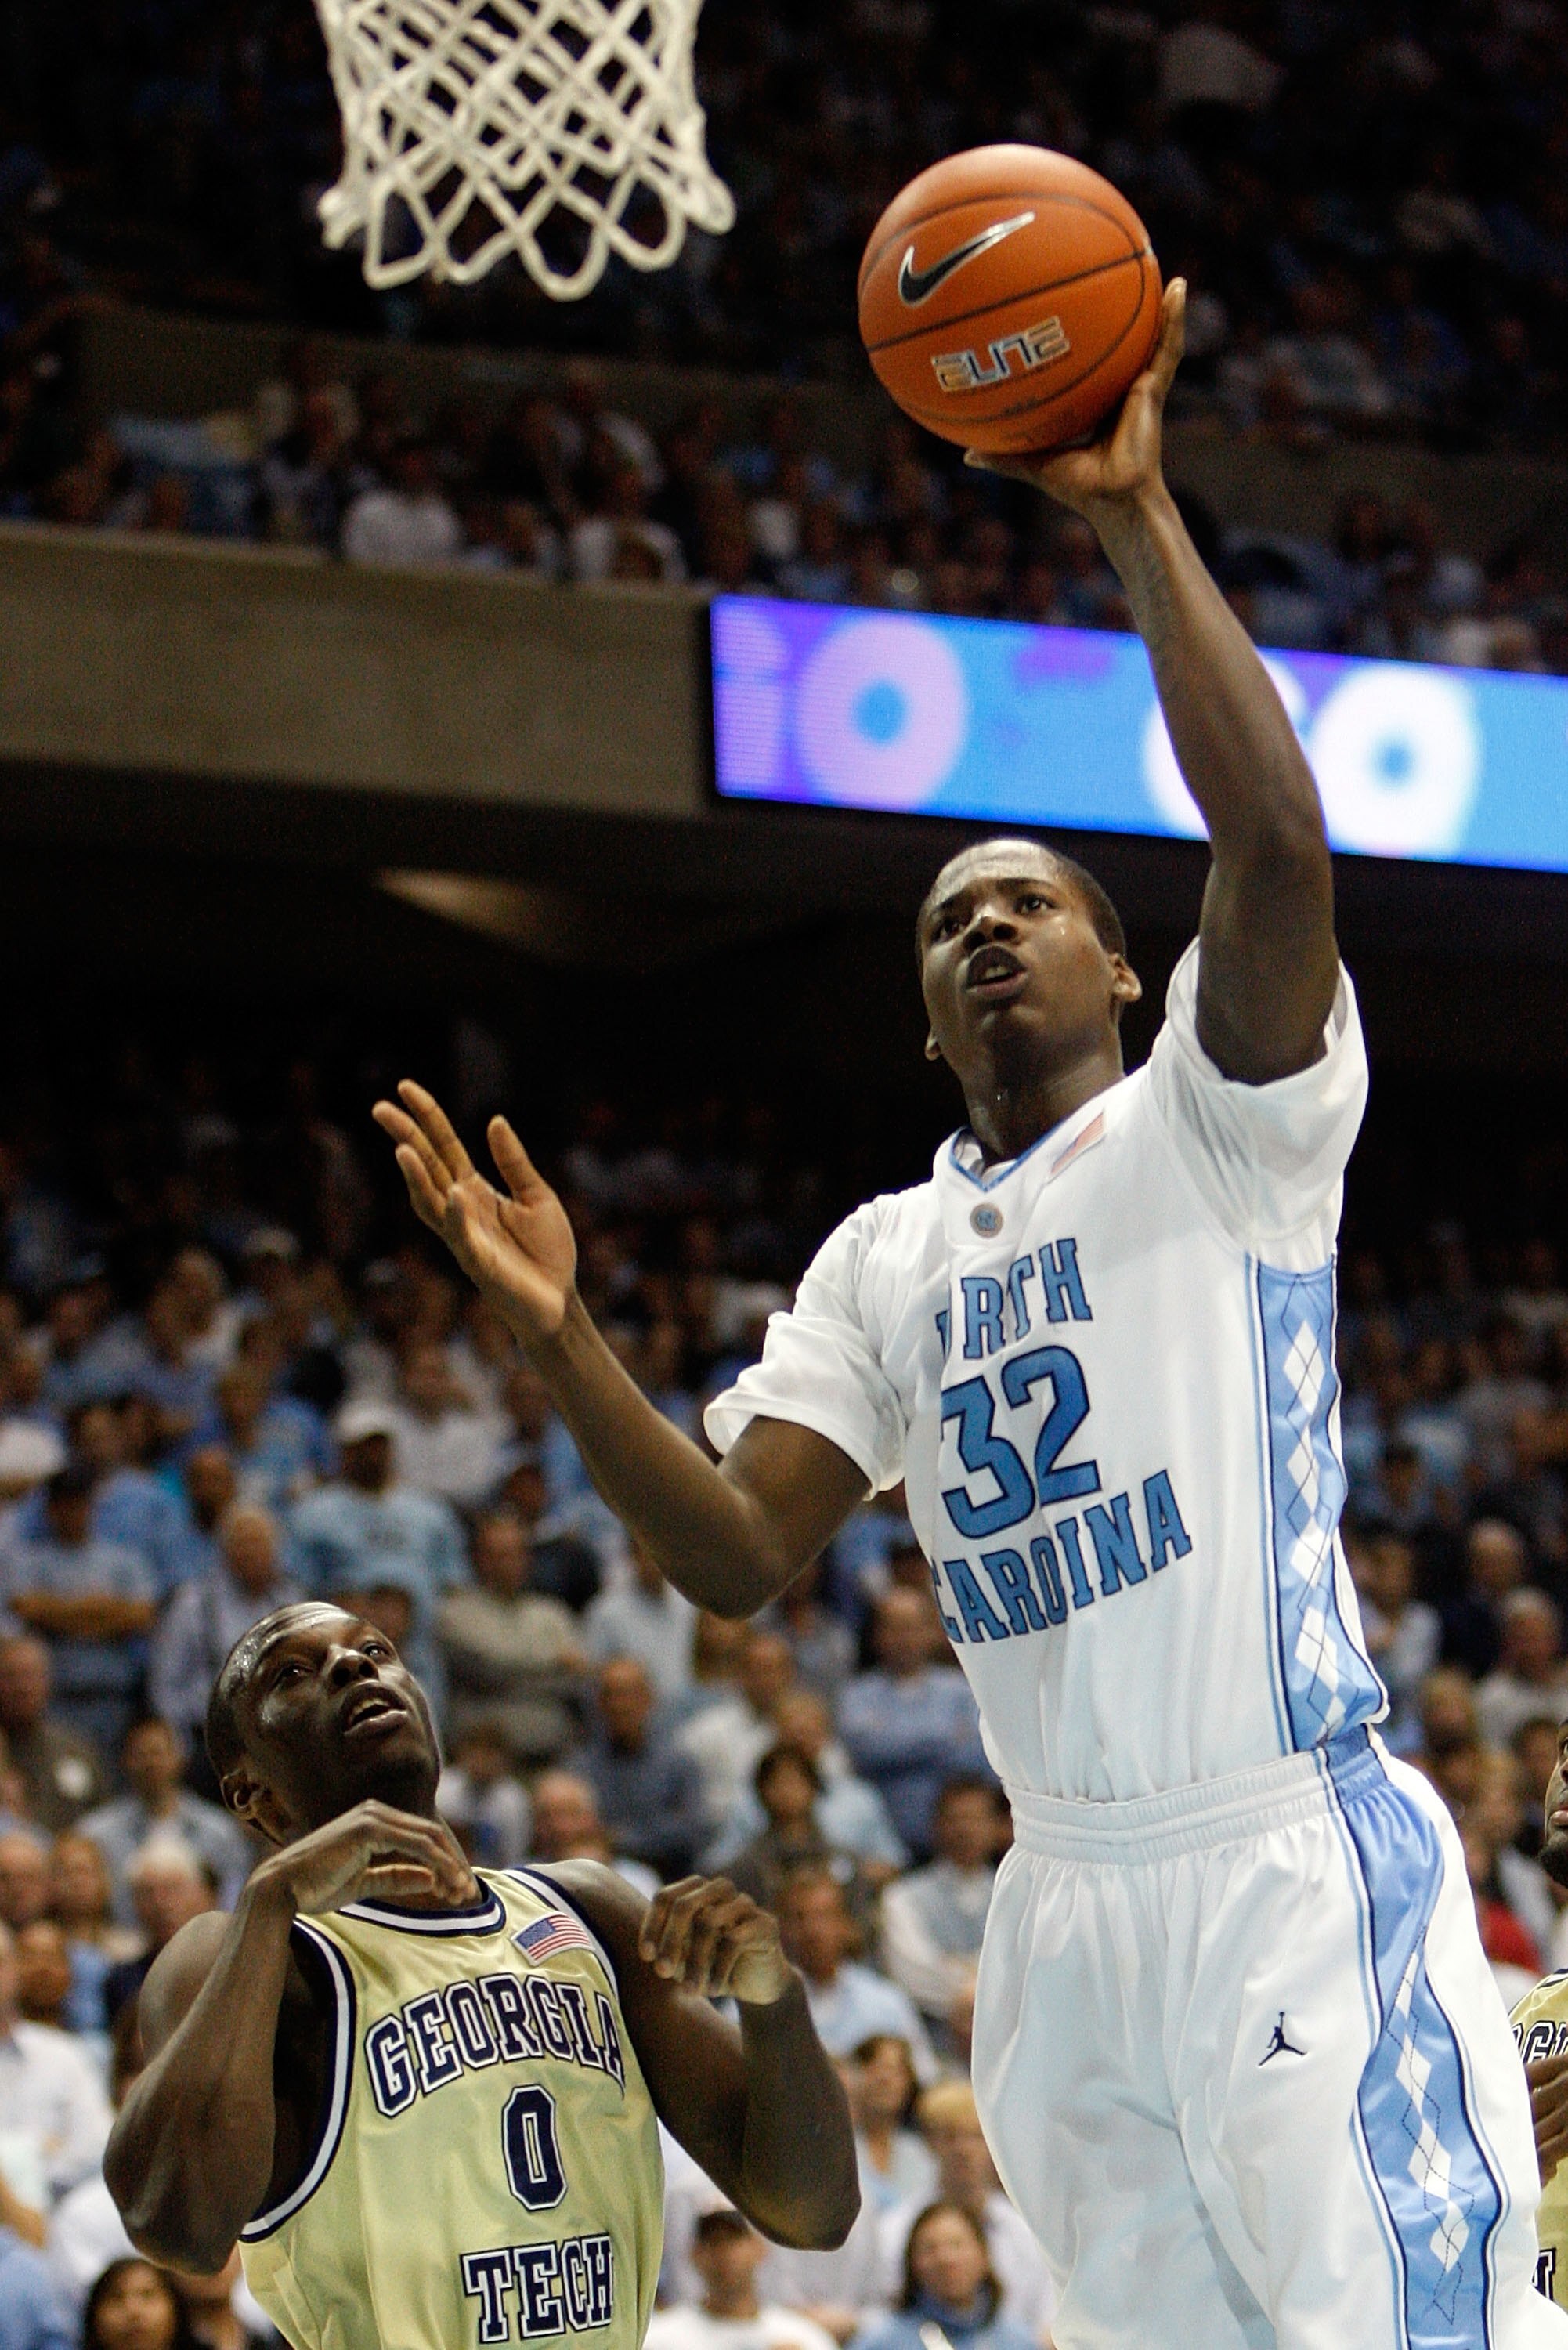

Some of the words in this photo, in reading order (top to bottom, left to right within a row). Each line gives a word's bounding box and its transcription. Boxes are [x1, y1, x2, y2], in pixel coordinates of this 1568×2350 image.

[935, 1238, 1093, 1359] RTH
[941, 1344, 1101, 1540] 32
[365, 1972, 625, 2118] GEORGIA
[460, 2232, 615, 2345] TECH
